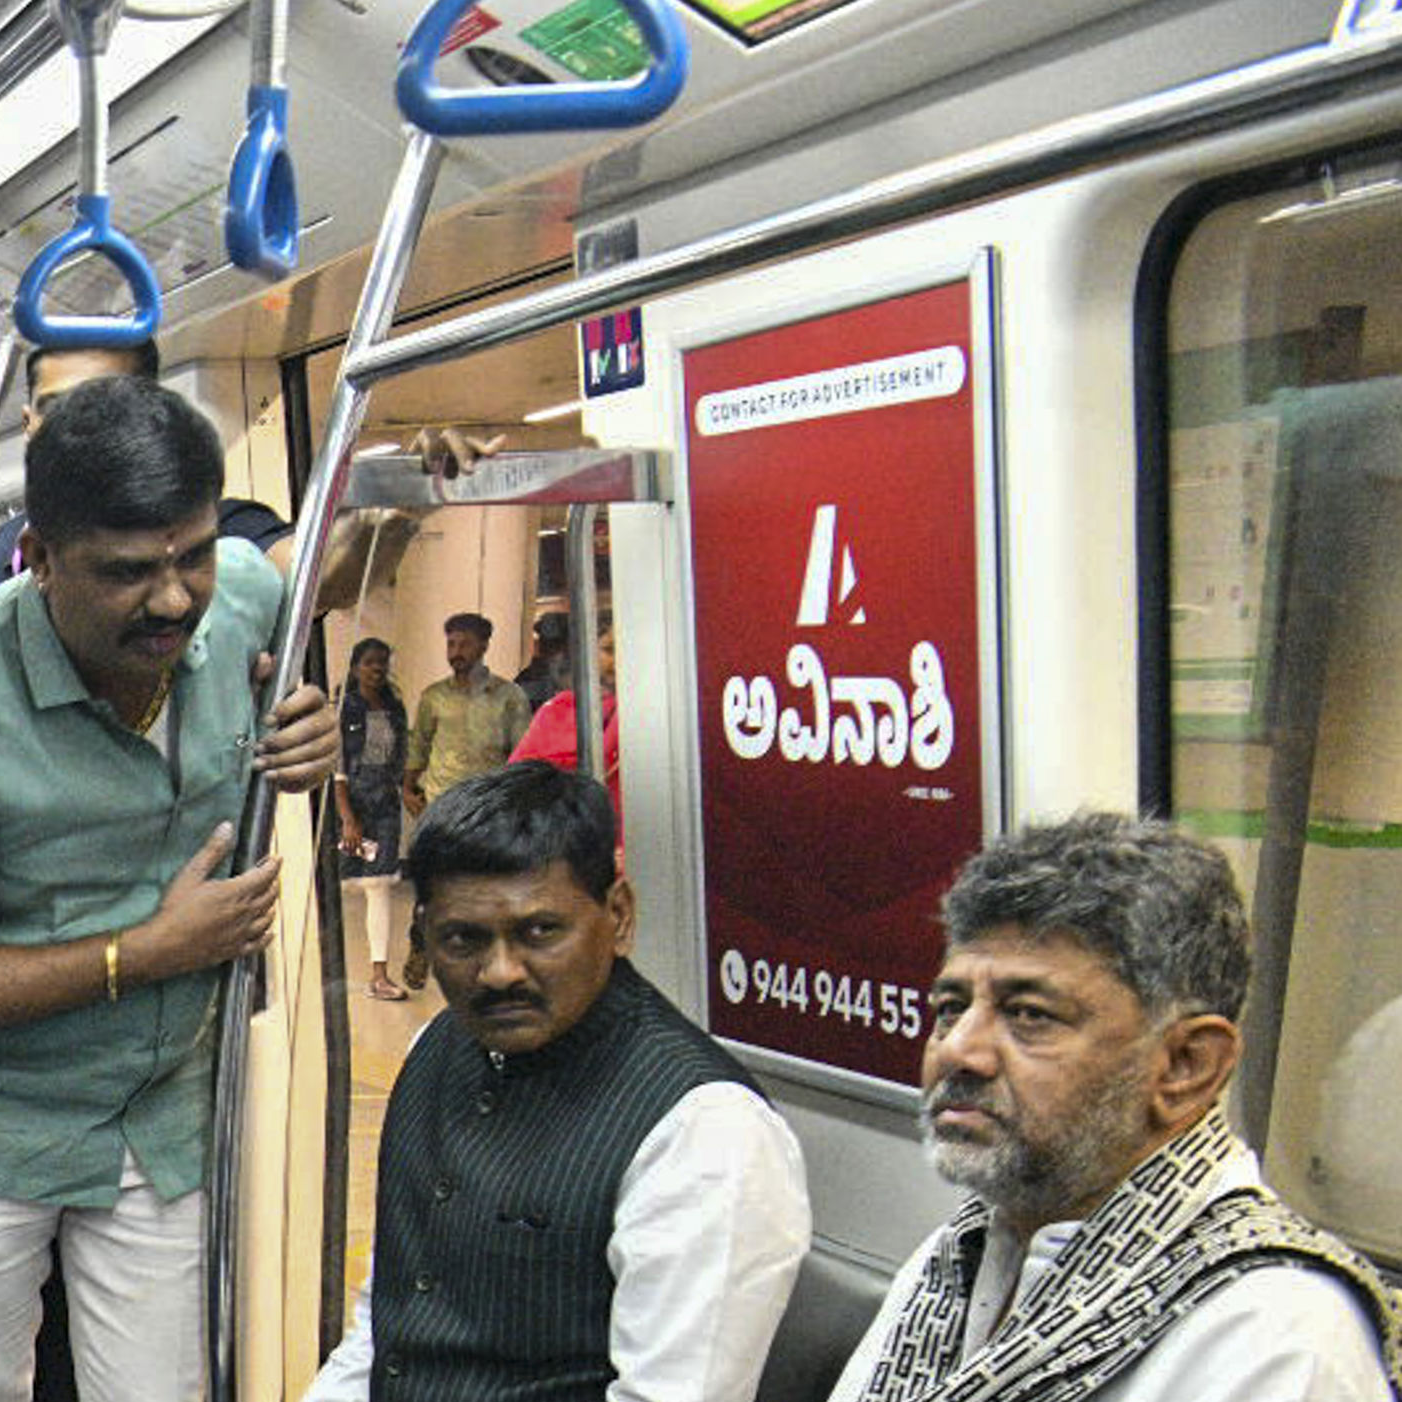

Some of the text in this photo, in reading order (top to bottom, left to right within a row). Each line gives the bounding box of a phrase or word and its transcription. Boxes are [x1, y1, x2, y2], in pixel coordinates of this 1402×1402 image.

[710, 360, 946, 423] CONTACT FOR ADVERTISEMENT
[722, 640, 954, 771] ಅವಿನಾಶಿ
[752, 958, 809, 1014] 944
[814, 969, 874, 1028] 944
